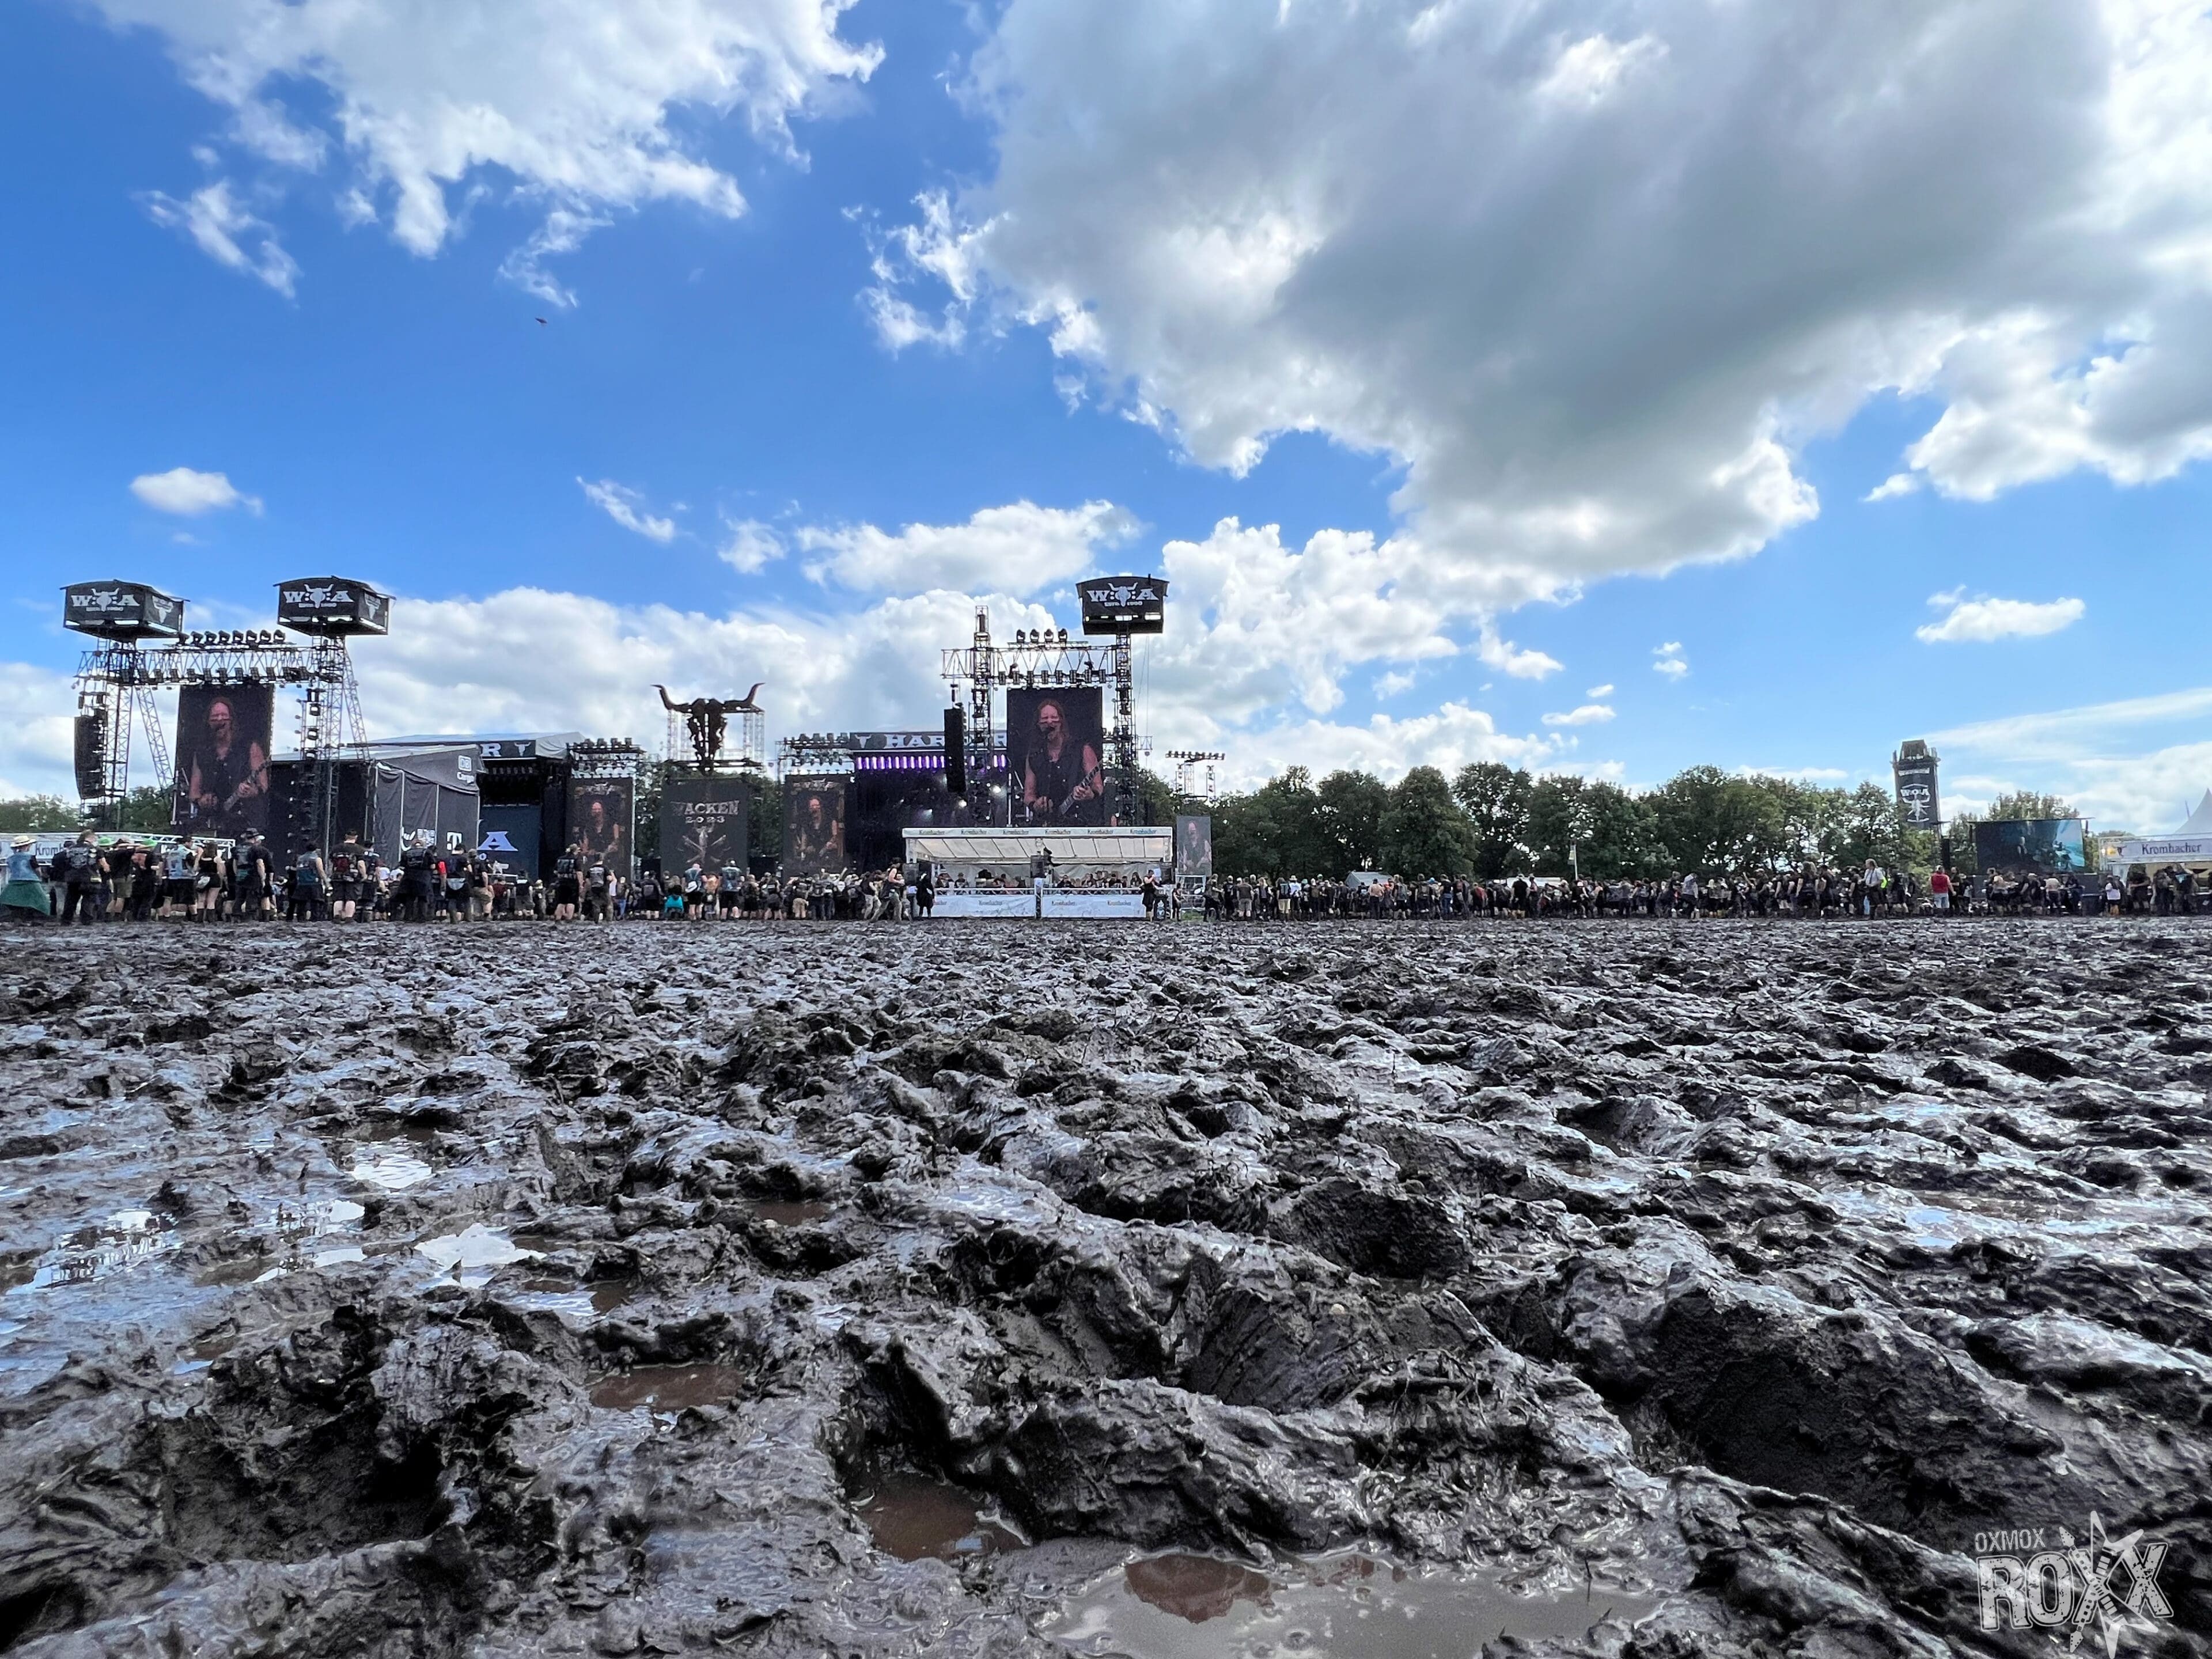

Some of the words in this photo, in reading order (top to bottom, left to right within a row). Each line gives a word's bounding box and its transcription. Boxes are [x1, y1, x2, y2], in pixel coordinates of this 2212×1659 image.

[685, 815, 725, 824] 2023
[35, 843, 64, 855] Kromb
[2141, 842, 2202, 855] Krombacher
